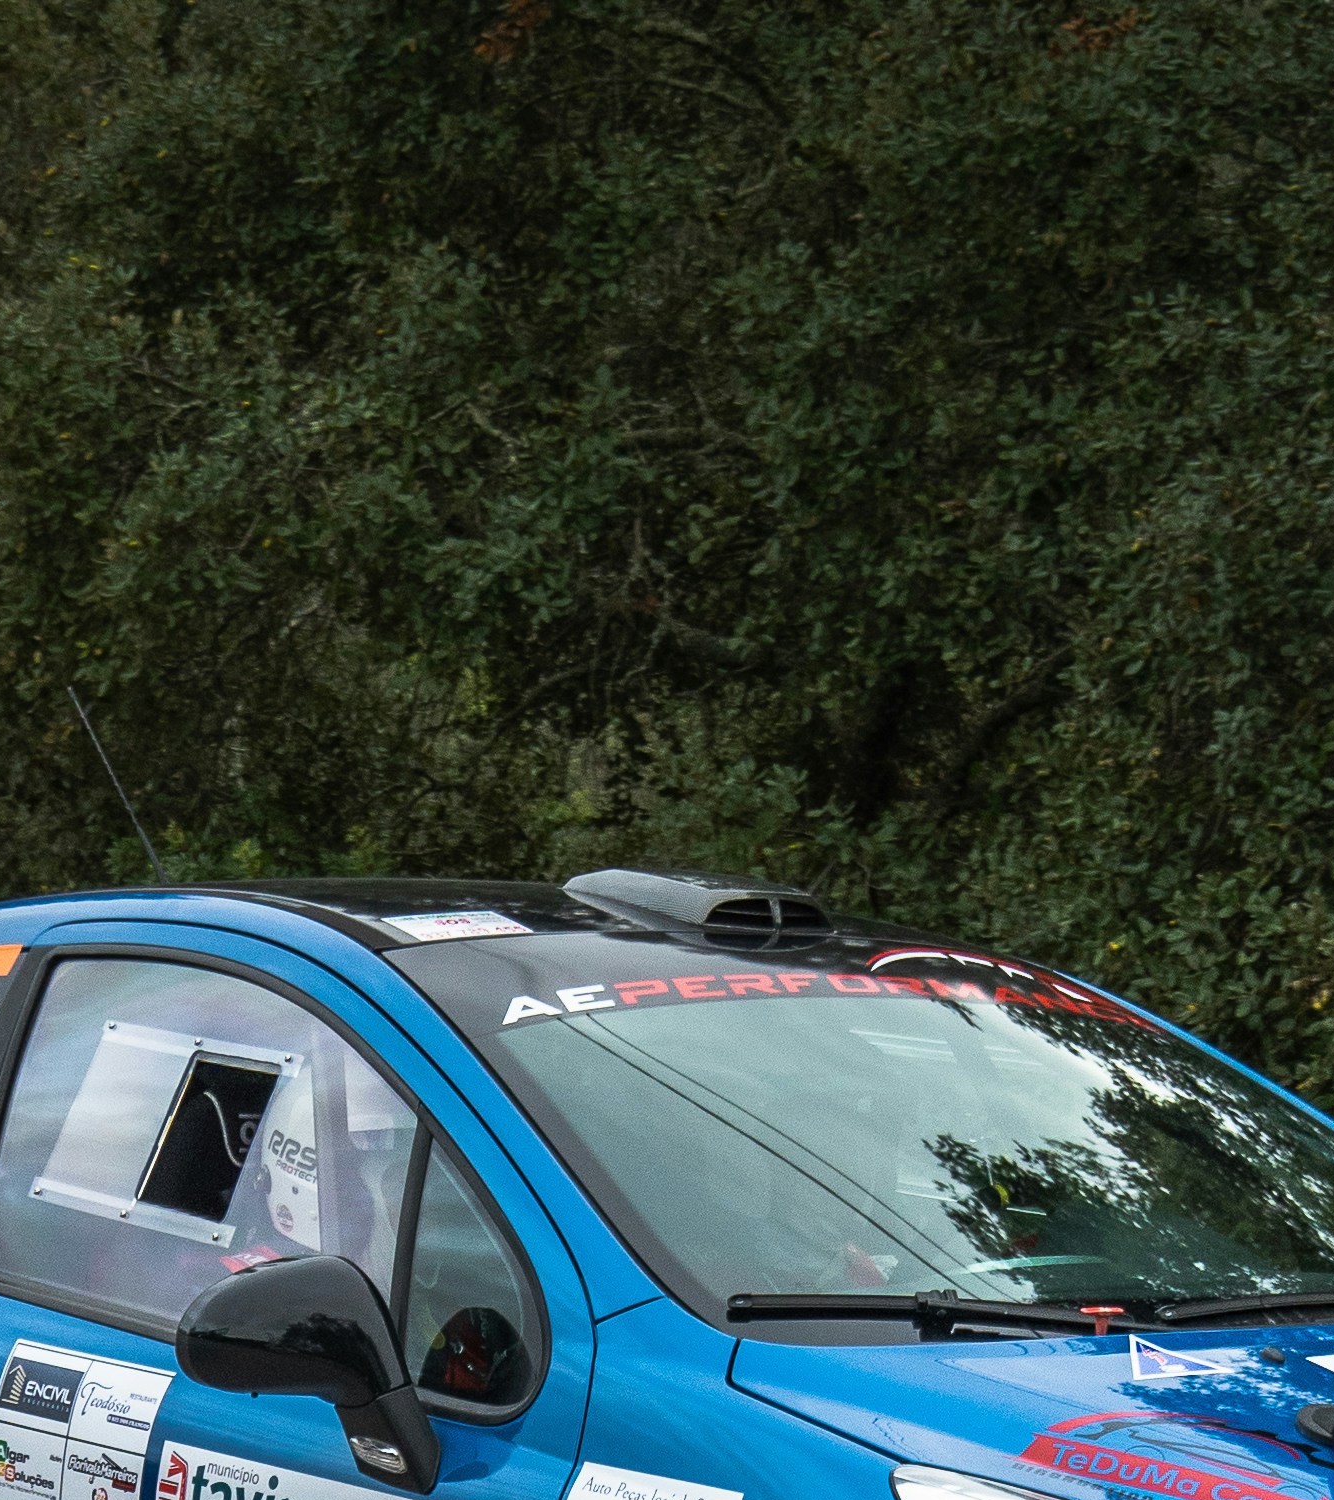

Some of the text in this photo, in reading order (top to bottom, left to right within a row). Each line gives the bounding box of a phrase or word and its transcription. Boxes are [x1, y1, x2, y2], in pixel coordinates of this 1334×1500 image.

[268, 1129, 318, 1172] RRS
[24, 1380, 71, 1405] ENCIVIL
[81, 1381, 131, 1416] Teodósio
[207, 1462, 260, 1485] município
[1052, 1442, 1201, 1496] TeDuMa
[582, 1476, 612, 1495] Auto
